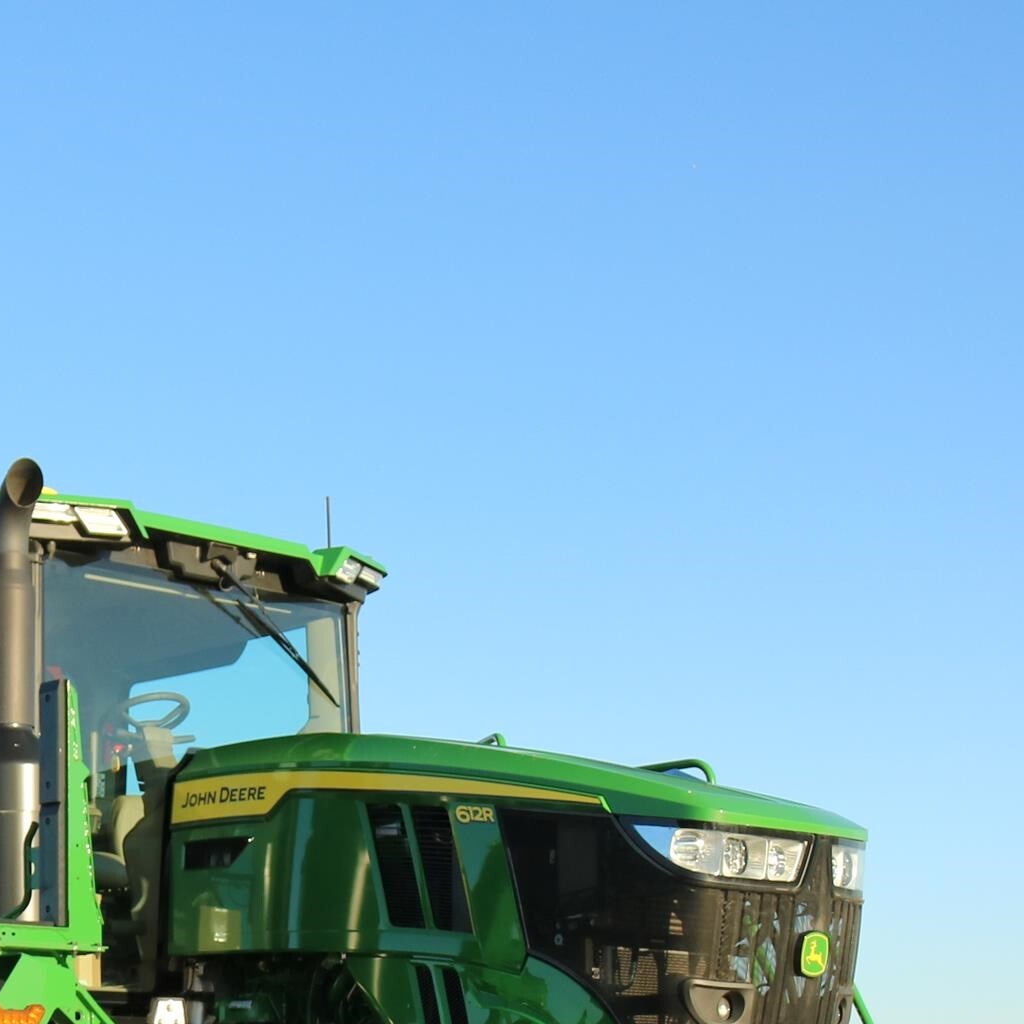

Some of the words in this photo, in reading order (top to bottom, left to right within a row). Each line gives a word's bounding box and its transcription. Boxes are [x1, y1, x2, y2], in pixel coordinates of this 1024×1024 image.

[181, 790, 217, 808] JOHN
[219, 785, 267, 803] DEERE
[455, 805, 495, 823] 612R
